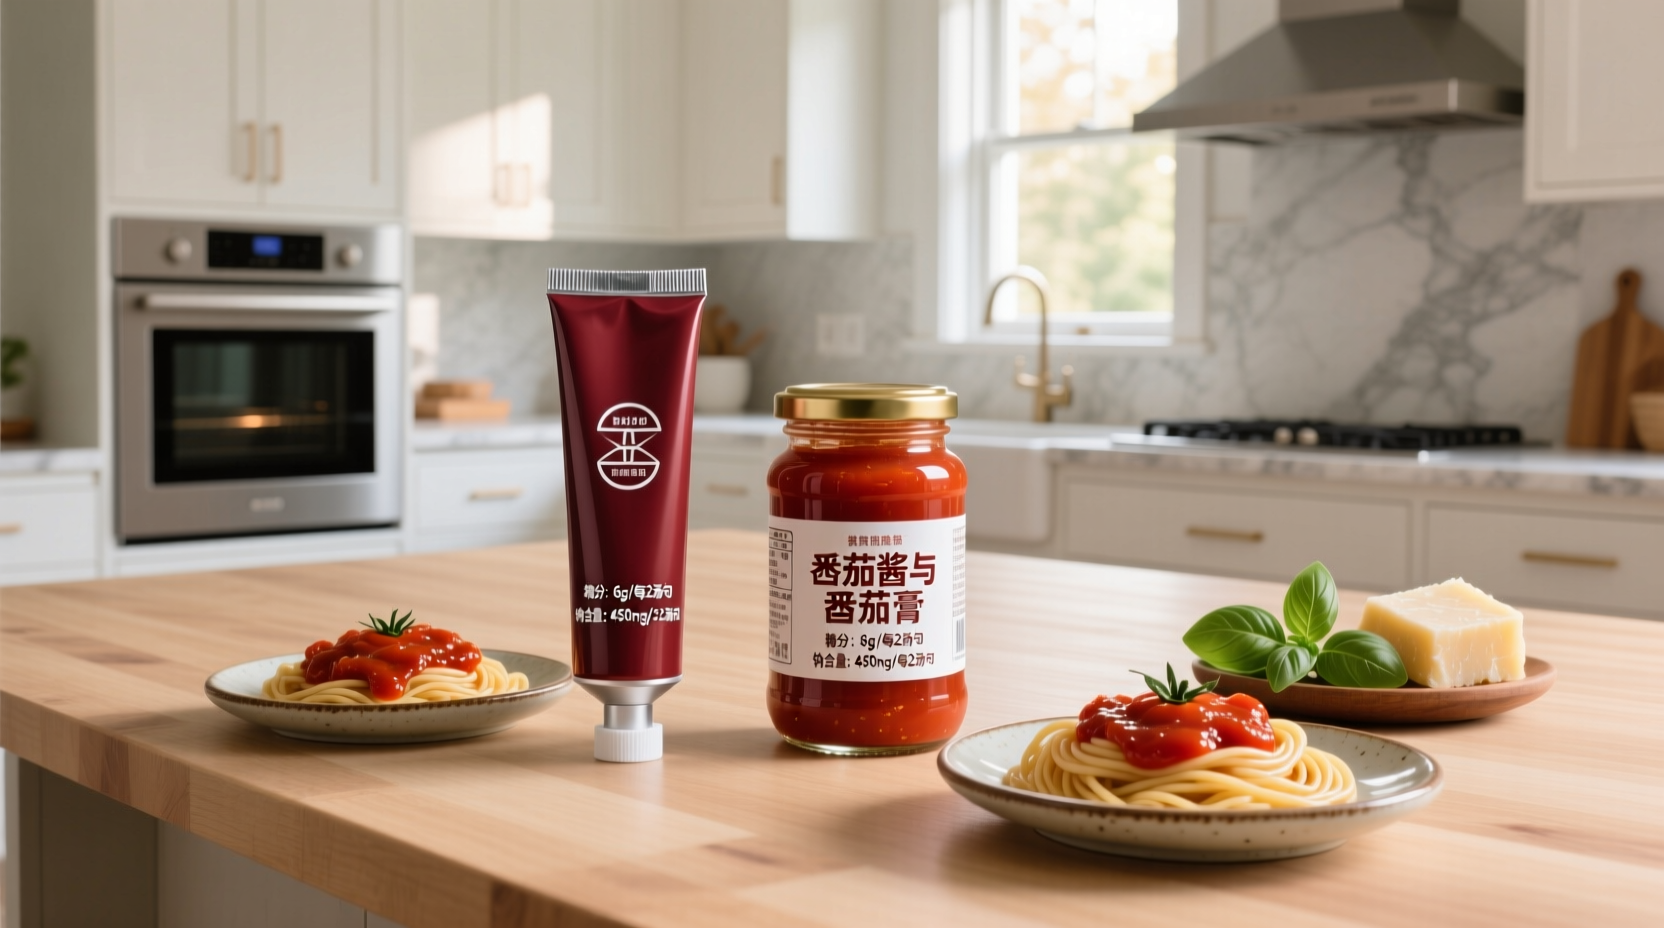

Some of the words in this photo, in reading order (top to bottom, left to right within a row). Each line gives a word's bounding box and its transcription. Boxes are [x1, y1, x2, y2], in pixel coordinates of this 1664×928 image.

[810, 551, 936, 587] 番茄酱与
[824, 589, 924, 624] 番茄膏
